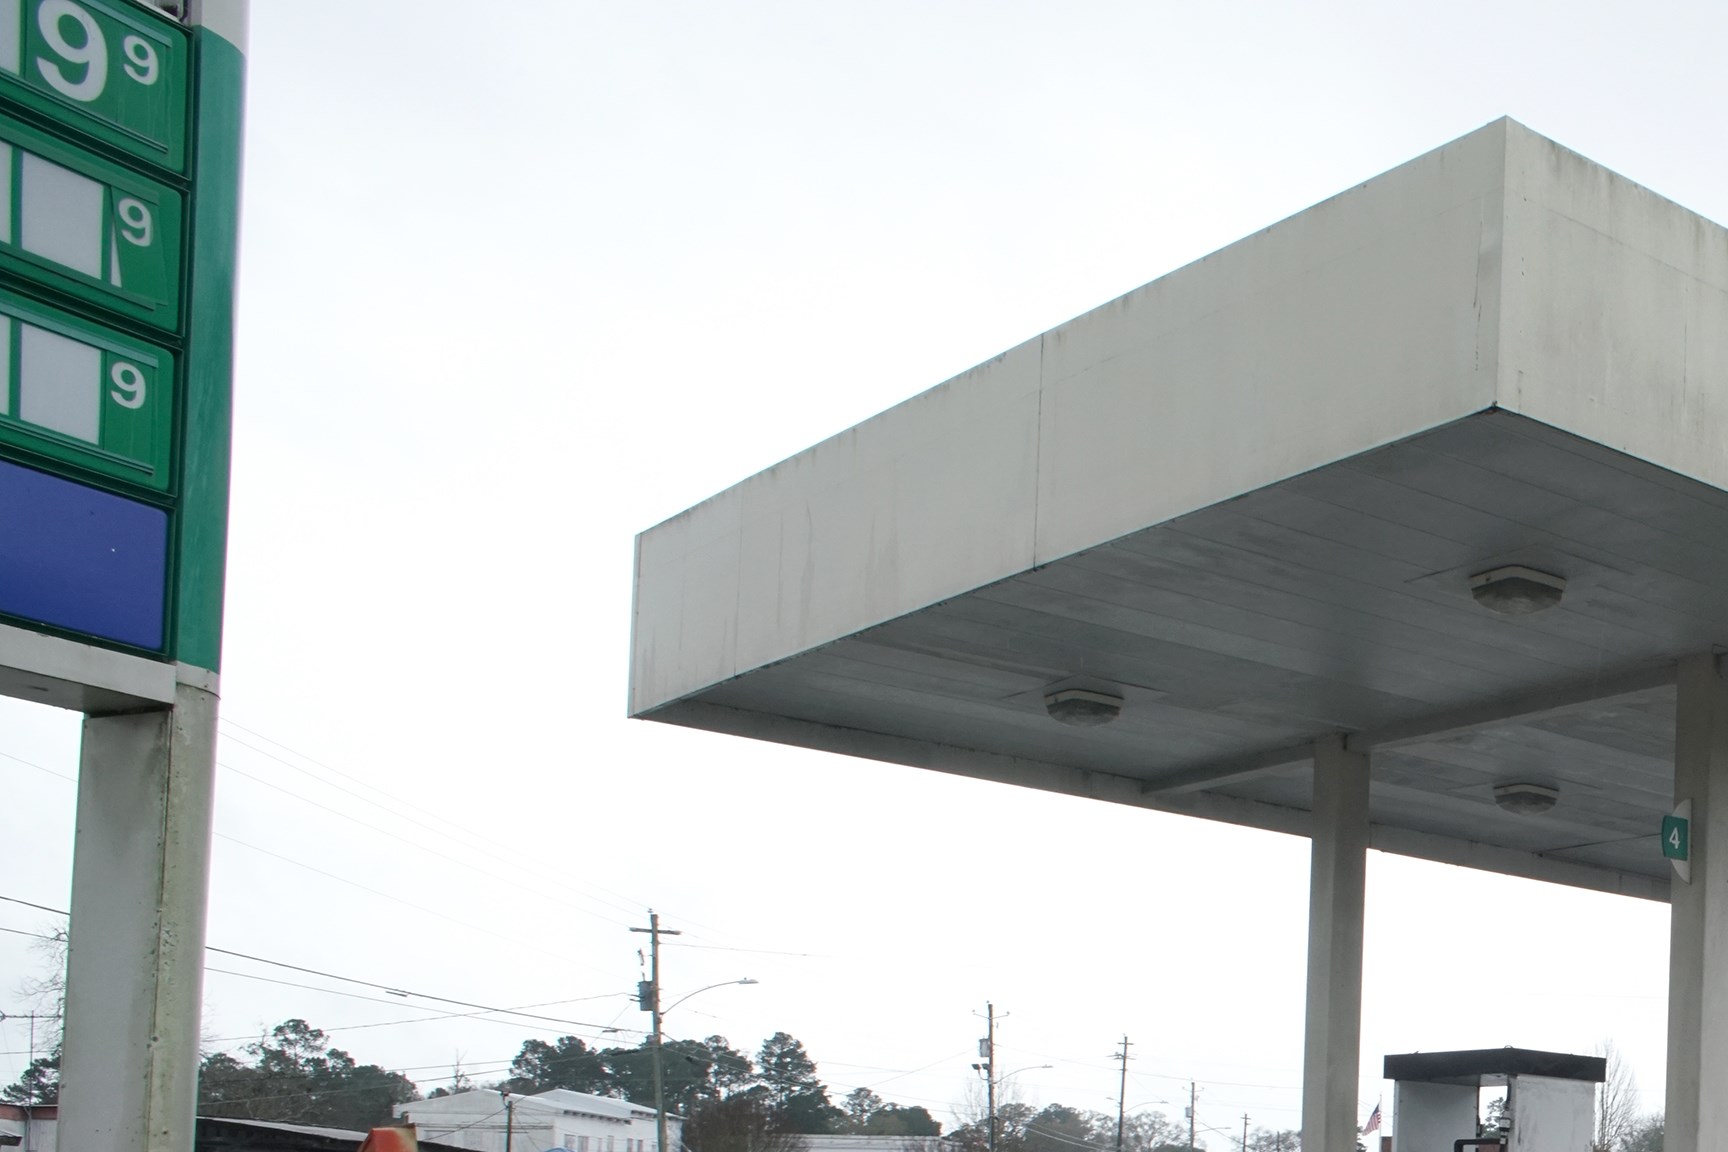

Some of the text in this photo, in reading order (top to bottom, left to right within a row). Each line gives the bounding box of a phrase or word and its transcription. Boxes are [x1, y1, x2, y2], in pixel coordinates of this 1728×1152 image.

[118, 197, 154, 248] 9
[110, 360, 147, 410] 9
[1669, 826, 1681, 850] 4
